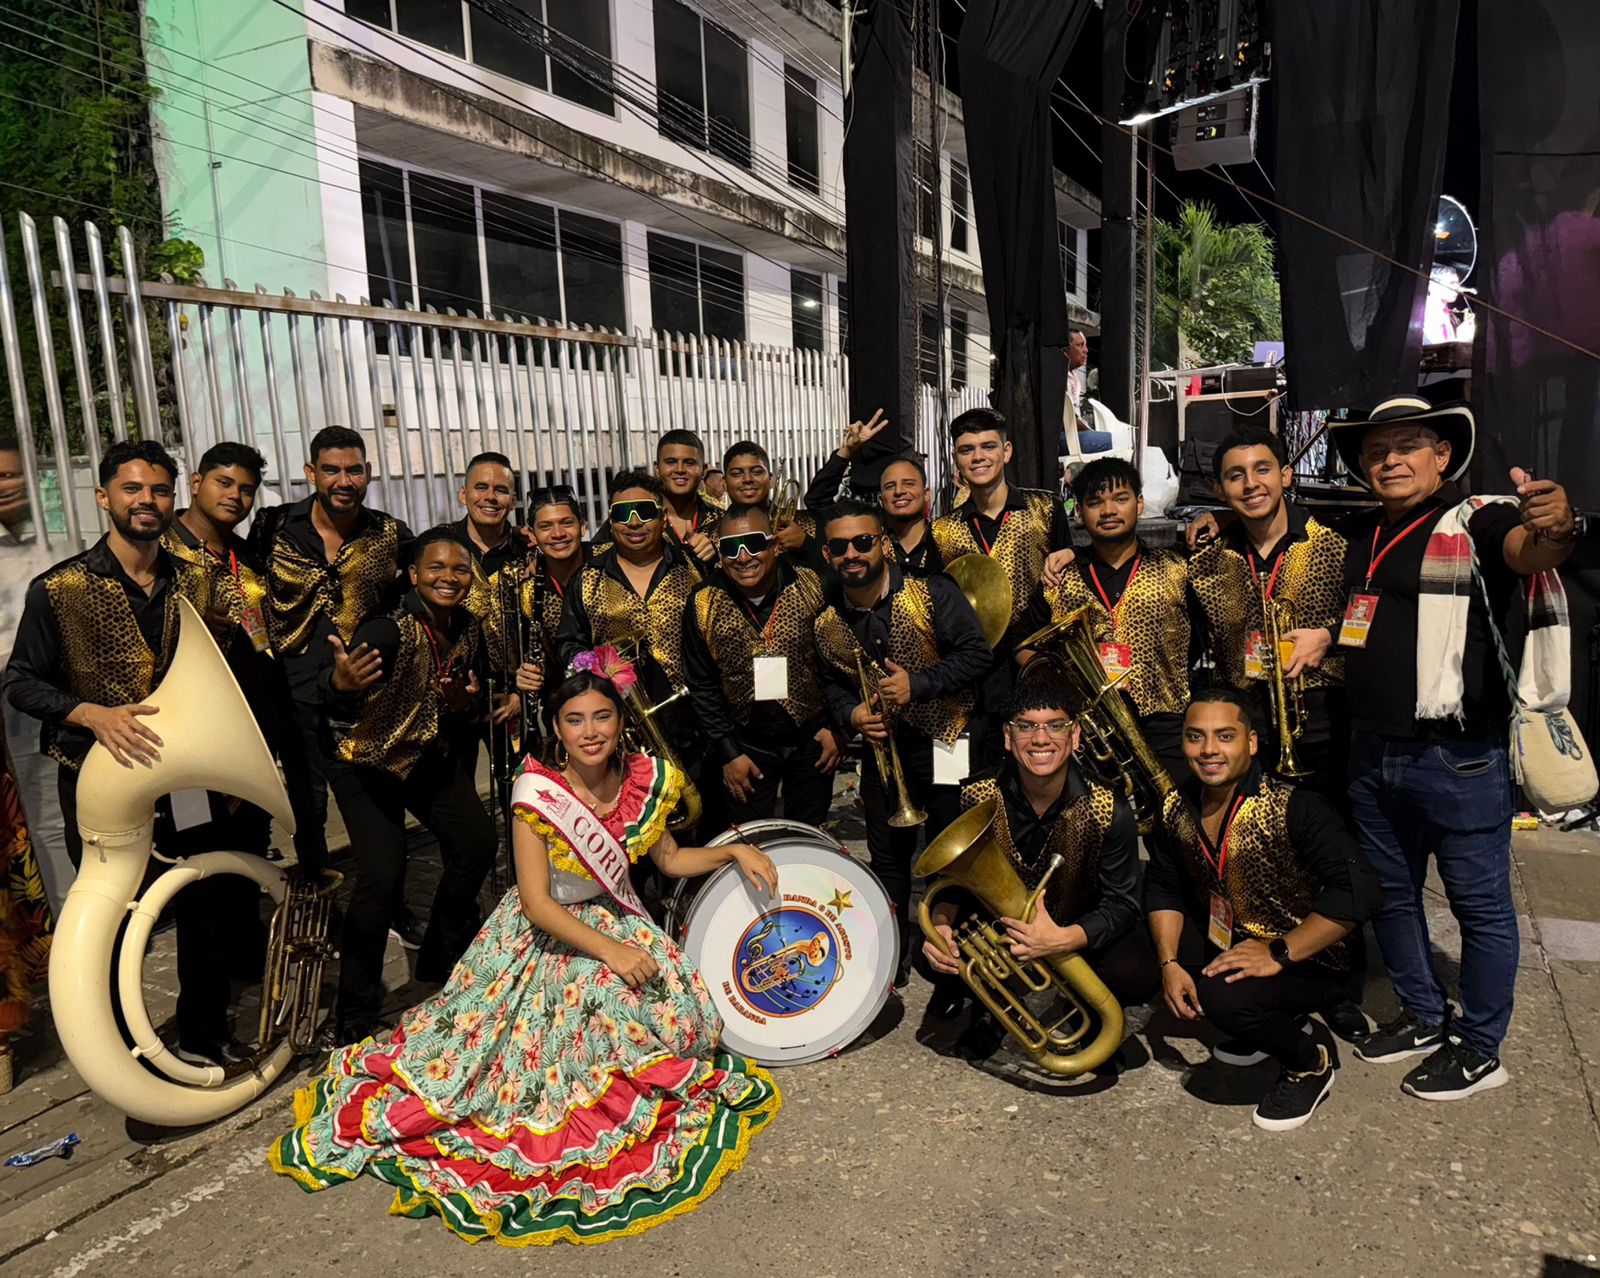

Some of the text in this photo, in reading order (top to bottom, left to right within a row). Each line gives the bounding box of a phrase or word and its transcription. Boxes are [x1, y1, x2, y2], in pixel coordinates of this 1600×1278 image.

[783, 893, 818, 908] BANDA
[824, 909, 838, 923] DE
[835, 922, 852, 961] AGOSTO
[722, 980, 732, 996] DE
